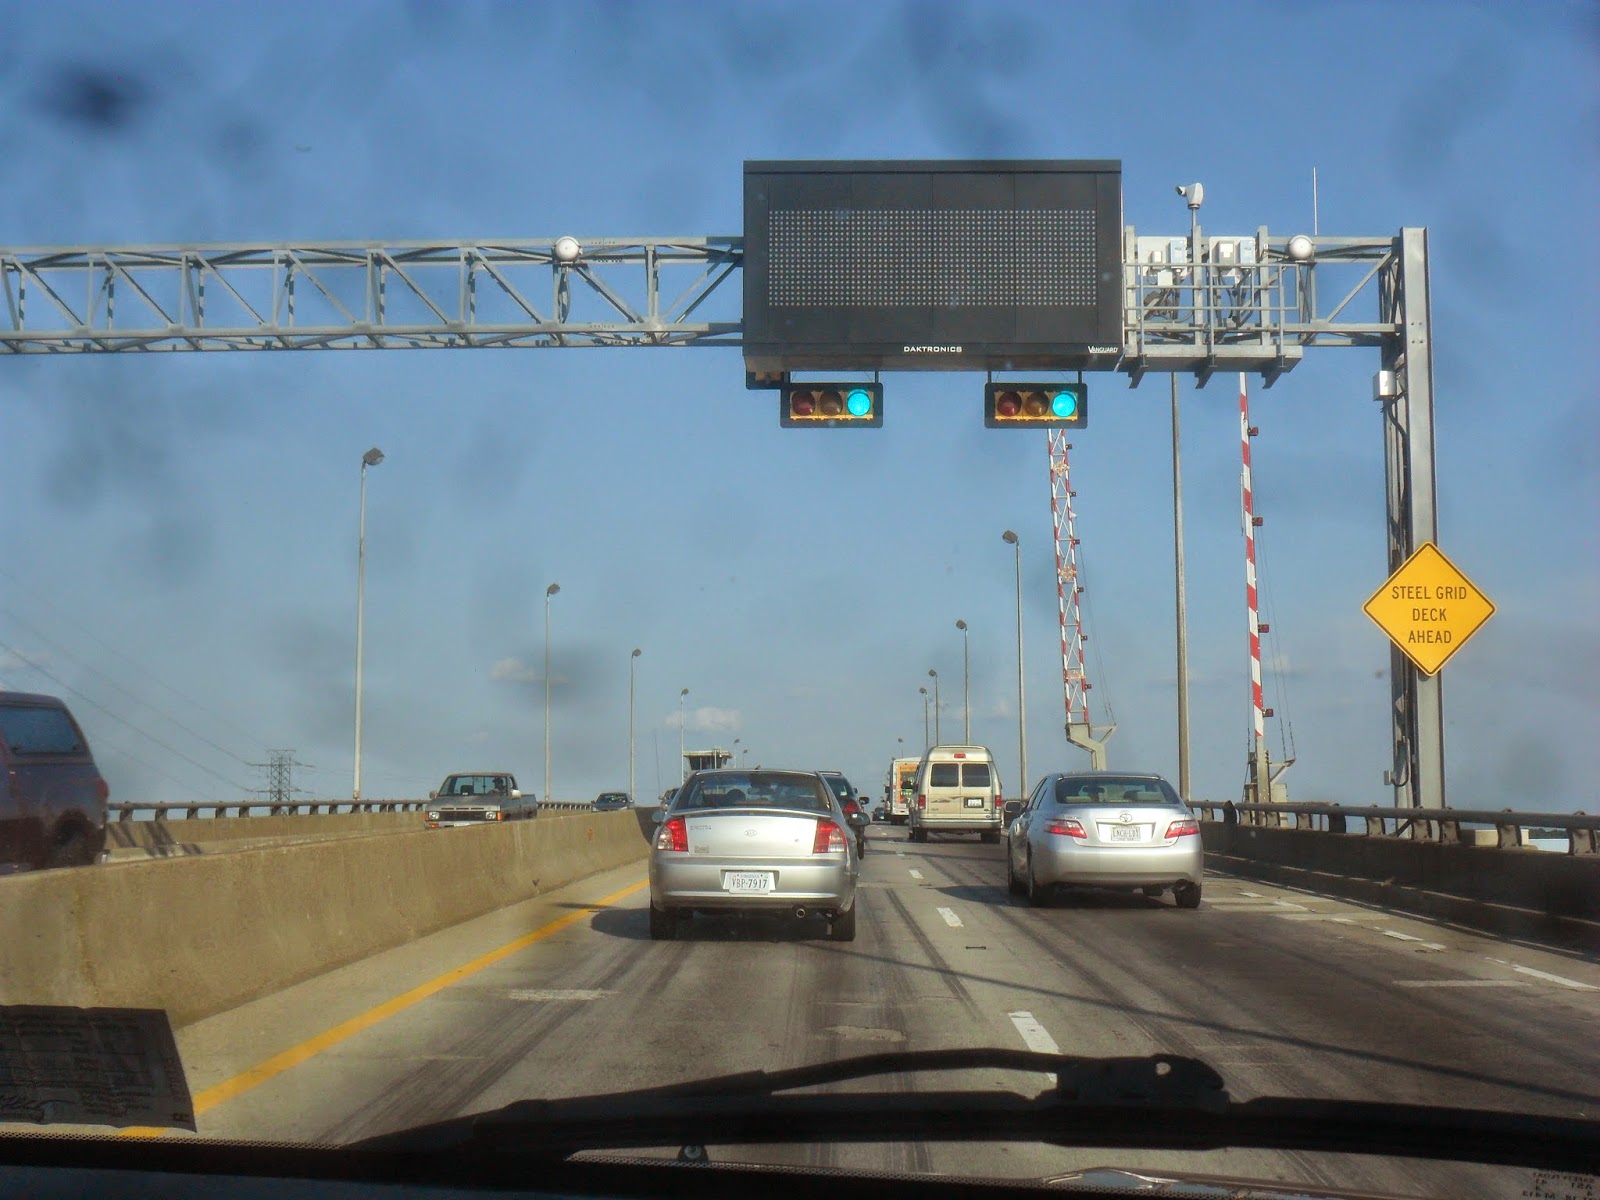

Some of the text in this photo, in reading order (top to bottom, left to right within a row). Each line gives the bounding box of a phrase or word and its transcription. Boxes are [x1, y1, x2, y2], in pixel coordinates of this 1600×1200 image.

[1391, 586, 1467, 600] STEEL GRID
[1412, 608, 1447, 621] DECK
[1408, 630, 1452, 643] AHEAD
